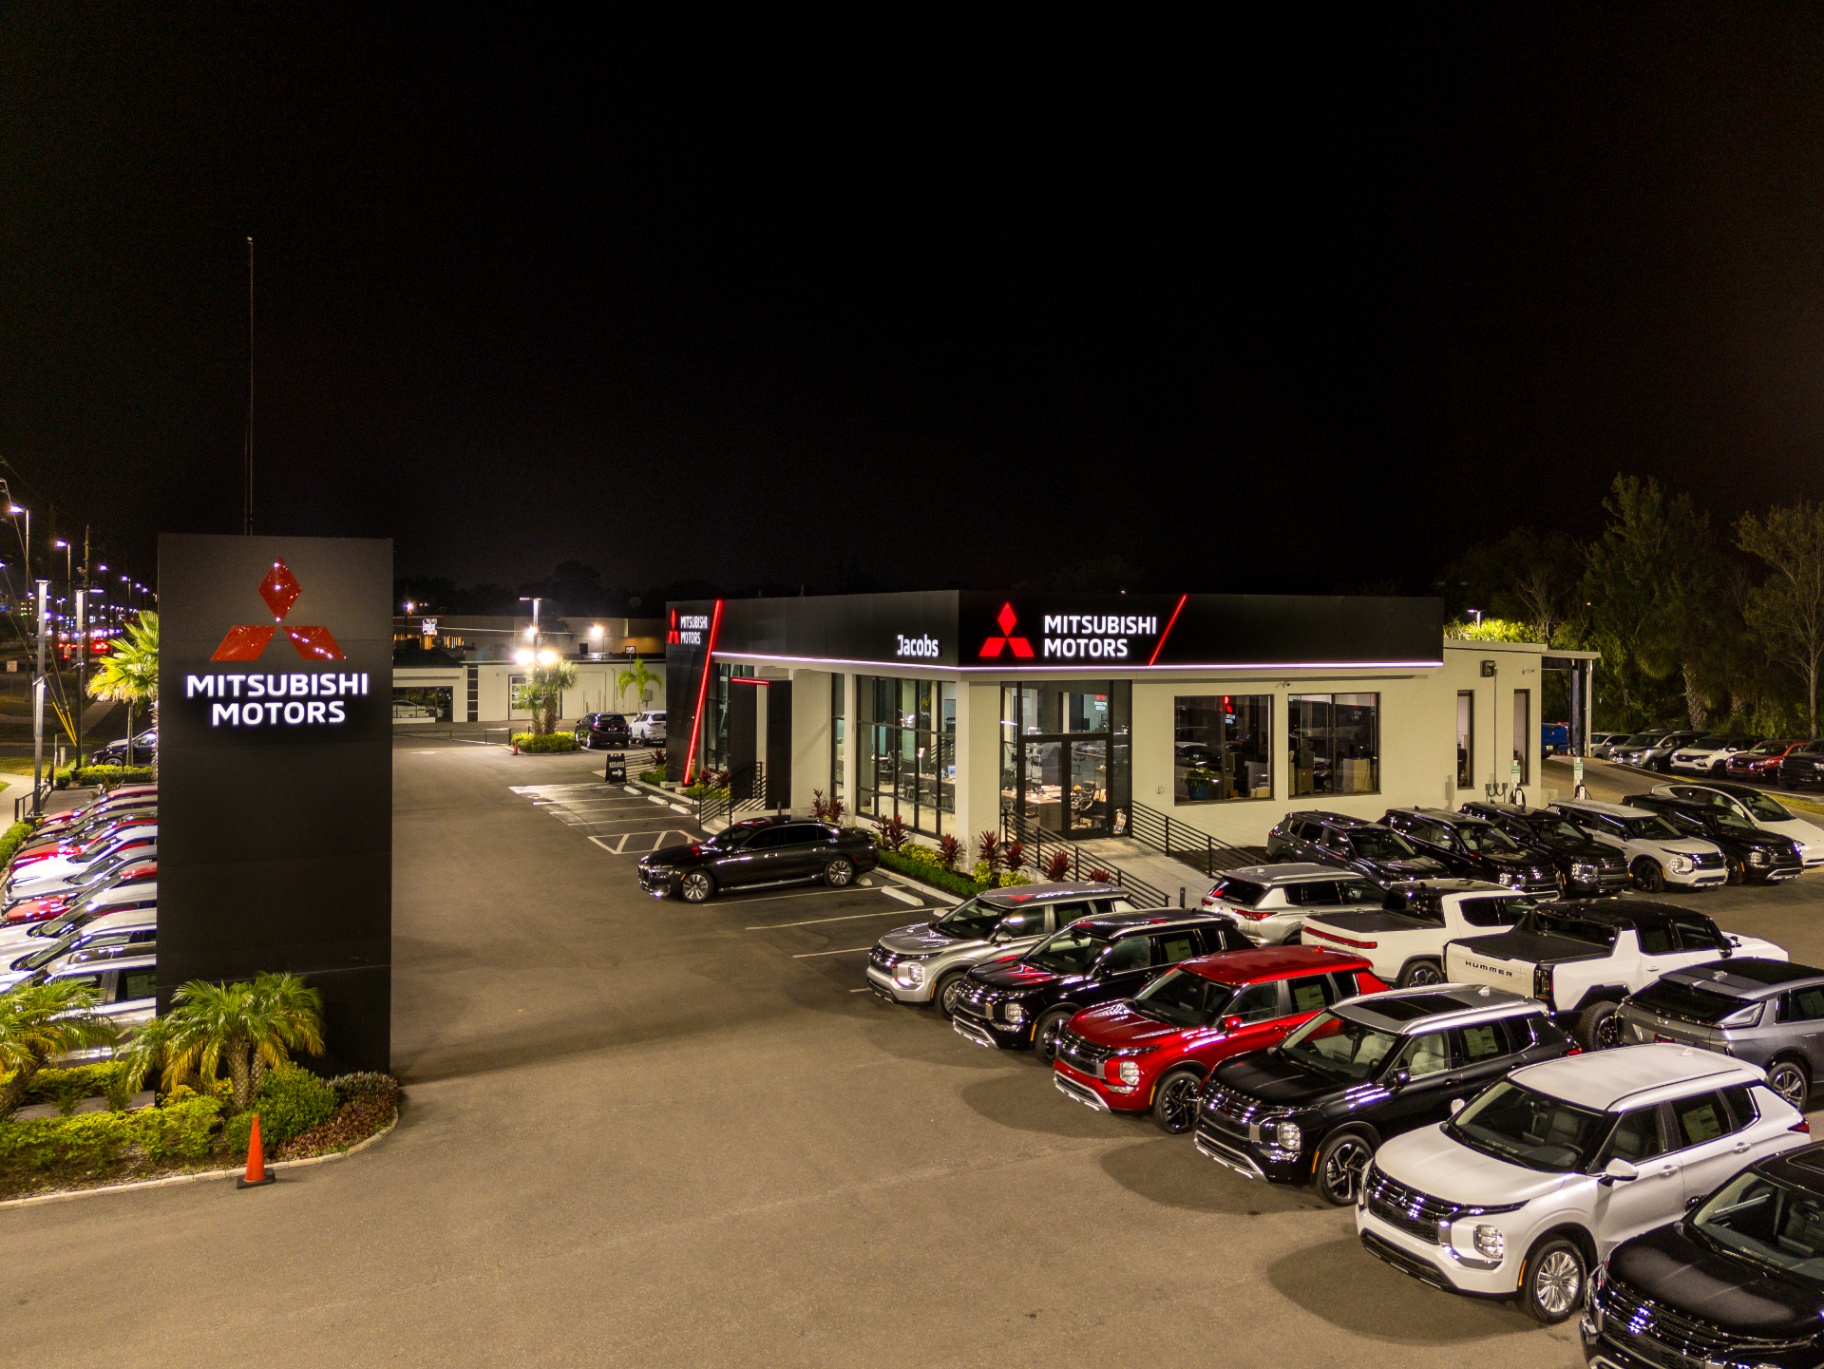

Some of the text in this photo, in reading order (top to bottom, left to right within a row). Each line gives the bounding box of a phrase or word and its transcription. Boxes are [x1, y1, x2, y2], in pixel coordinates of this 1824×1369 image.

[680, 615, 708, 629] MITSUBISHI
[1043, 615, 1157, 635] MITSUBISHI
[680, 631, 701, 645] MOTORS
[897, 633, 939, 657] Jacobs
[1043, 637, 1128, 658] MOTORS
[186, 673, 369, 698] MITSUBISHI
[211, 700, 346, 727] MOTORS
[1465, 960, 1513, 978] HUMMER
